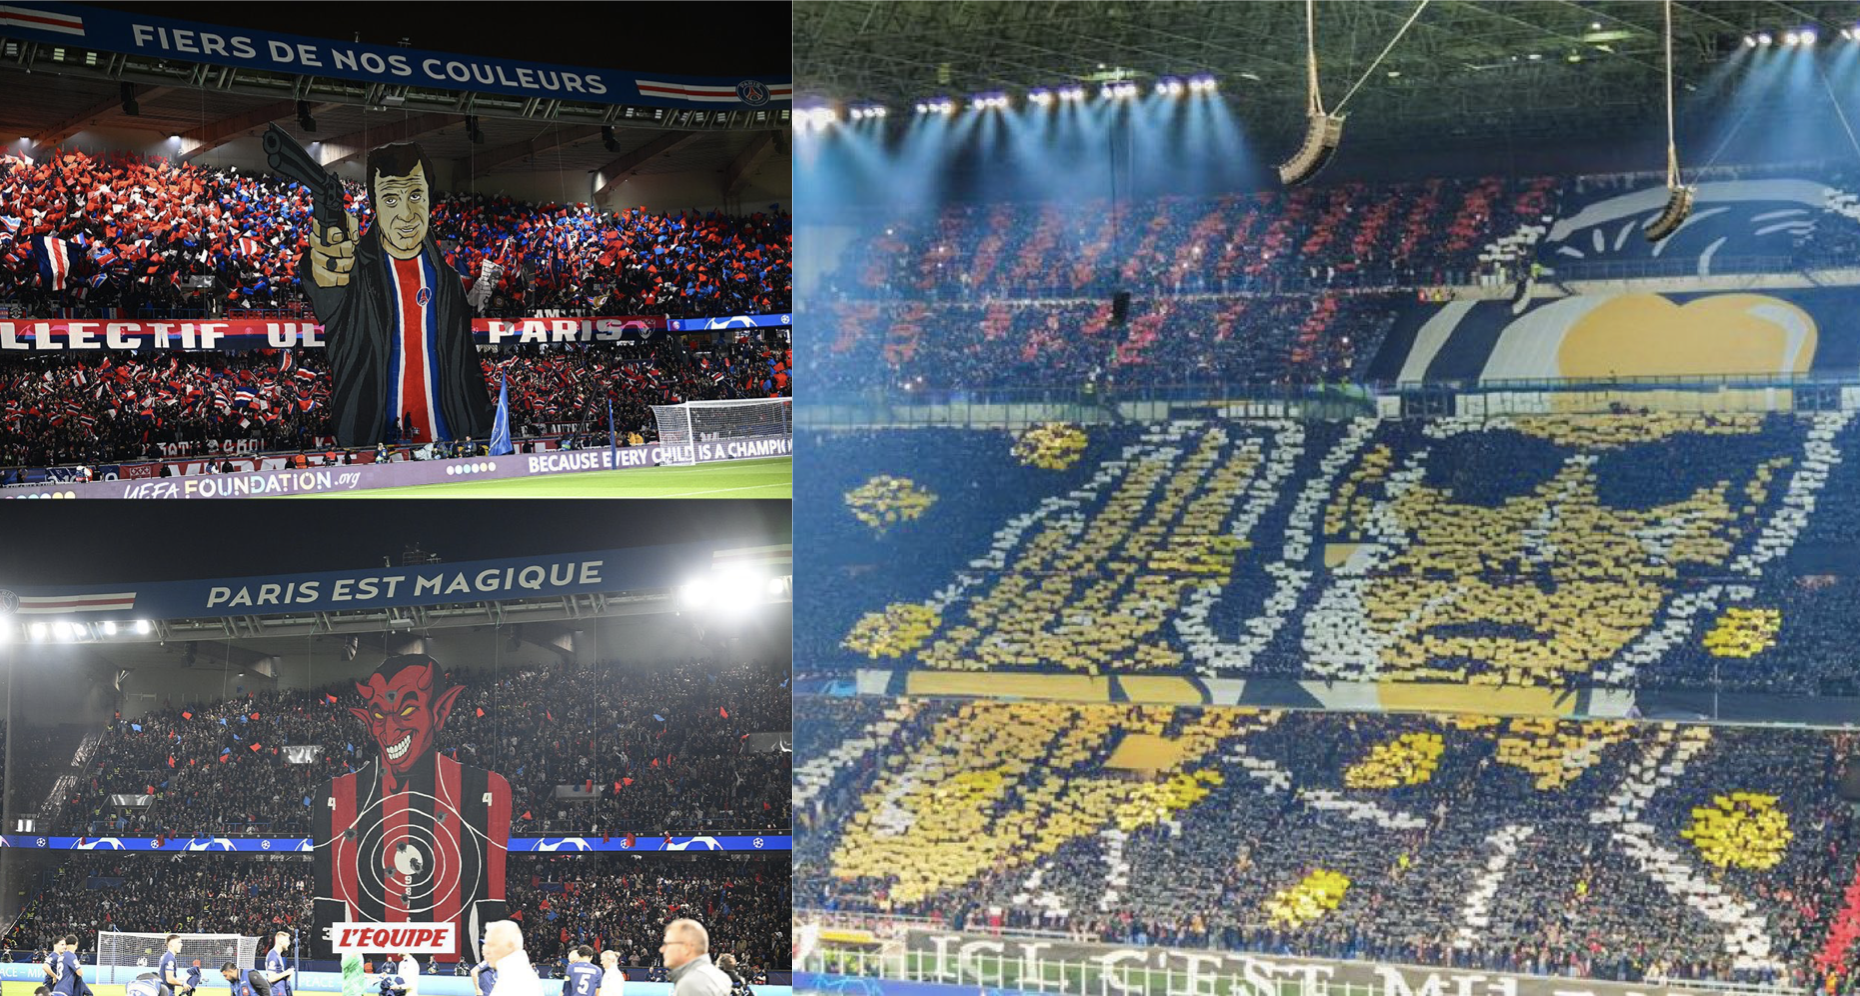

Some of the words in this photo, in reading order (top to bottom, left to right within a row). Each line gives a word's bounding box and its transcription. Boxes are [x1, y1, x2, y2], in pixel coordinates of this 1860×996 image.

[132, 24, 257, 59] FIERS
[268, 40, 323, 67] DE
[331, 48, 412, 76] NOS
[422, 58, 607, 94] COULEURS
[0, 322, 229, 350] LLECTIF
[487, 319, 623, 344] PARIS
[528, 452, 599, 473] BECAUSE
[652, 446, 693, 466] CHILD
[699, 445, 712, 460] IS
[714, 444, 726, 459] A
[123, 482, 180, 499] UEFA
[206, 581, 320, 609] PARIS
[331, 576, 405, 601] EST
[414, 560, 603, 596] MAGIQUE
[327, 797, 336, 811] 4
[482, 792, 492, 806] 4
[930, 936, 1068, 986] ICI
[577, 974, 591, 995] 5
